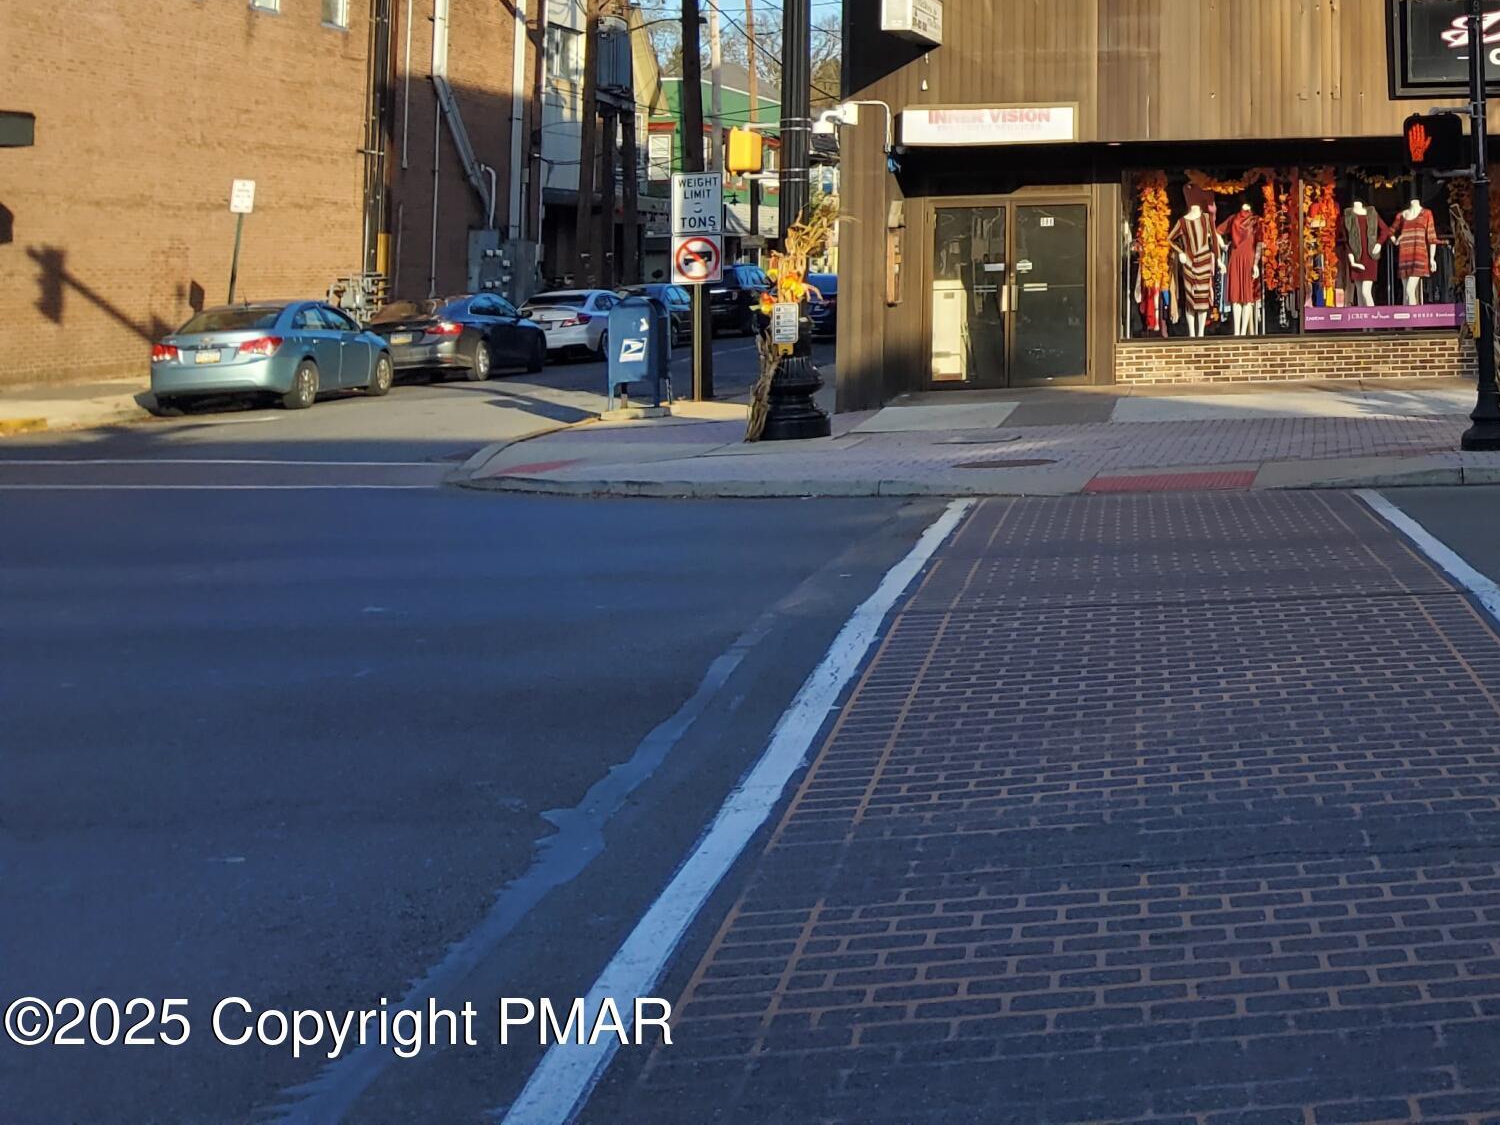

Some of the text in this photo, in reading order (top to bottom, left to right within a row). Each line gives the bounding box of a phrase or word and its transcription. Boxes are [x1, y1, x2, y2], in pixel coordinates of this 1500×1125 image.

[989, 108, 1051, 123] VISION
[678, 177, 718, 188] WEIGHT
[684, 189, 712, 199] LIMIT
[680, 216, 716, 228] TONS
